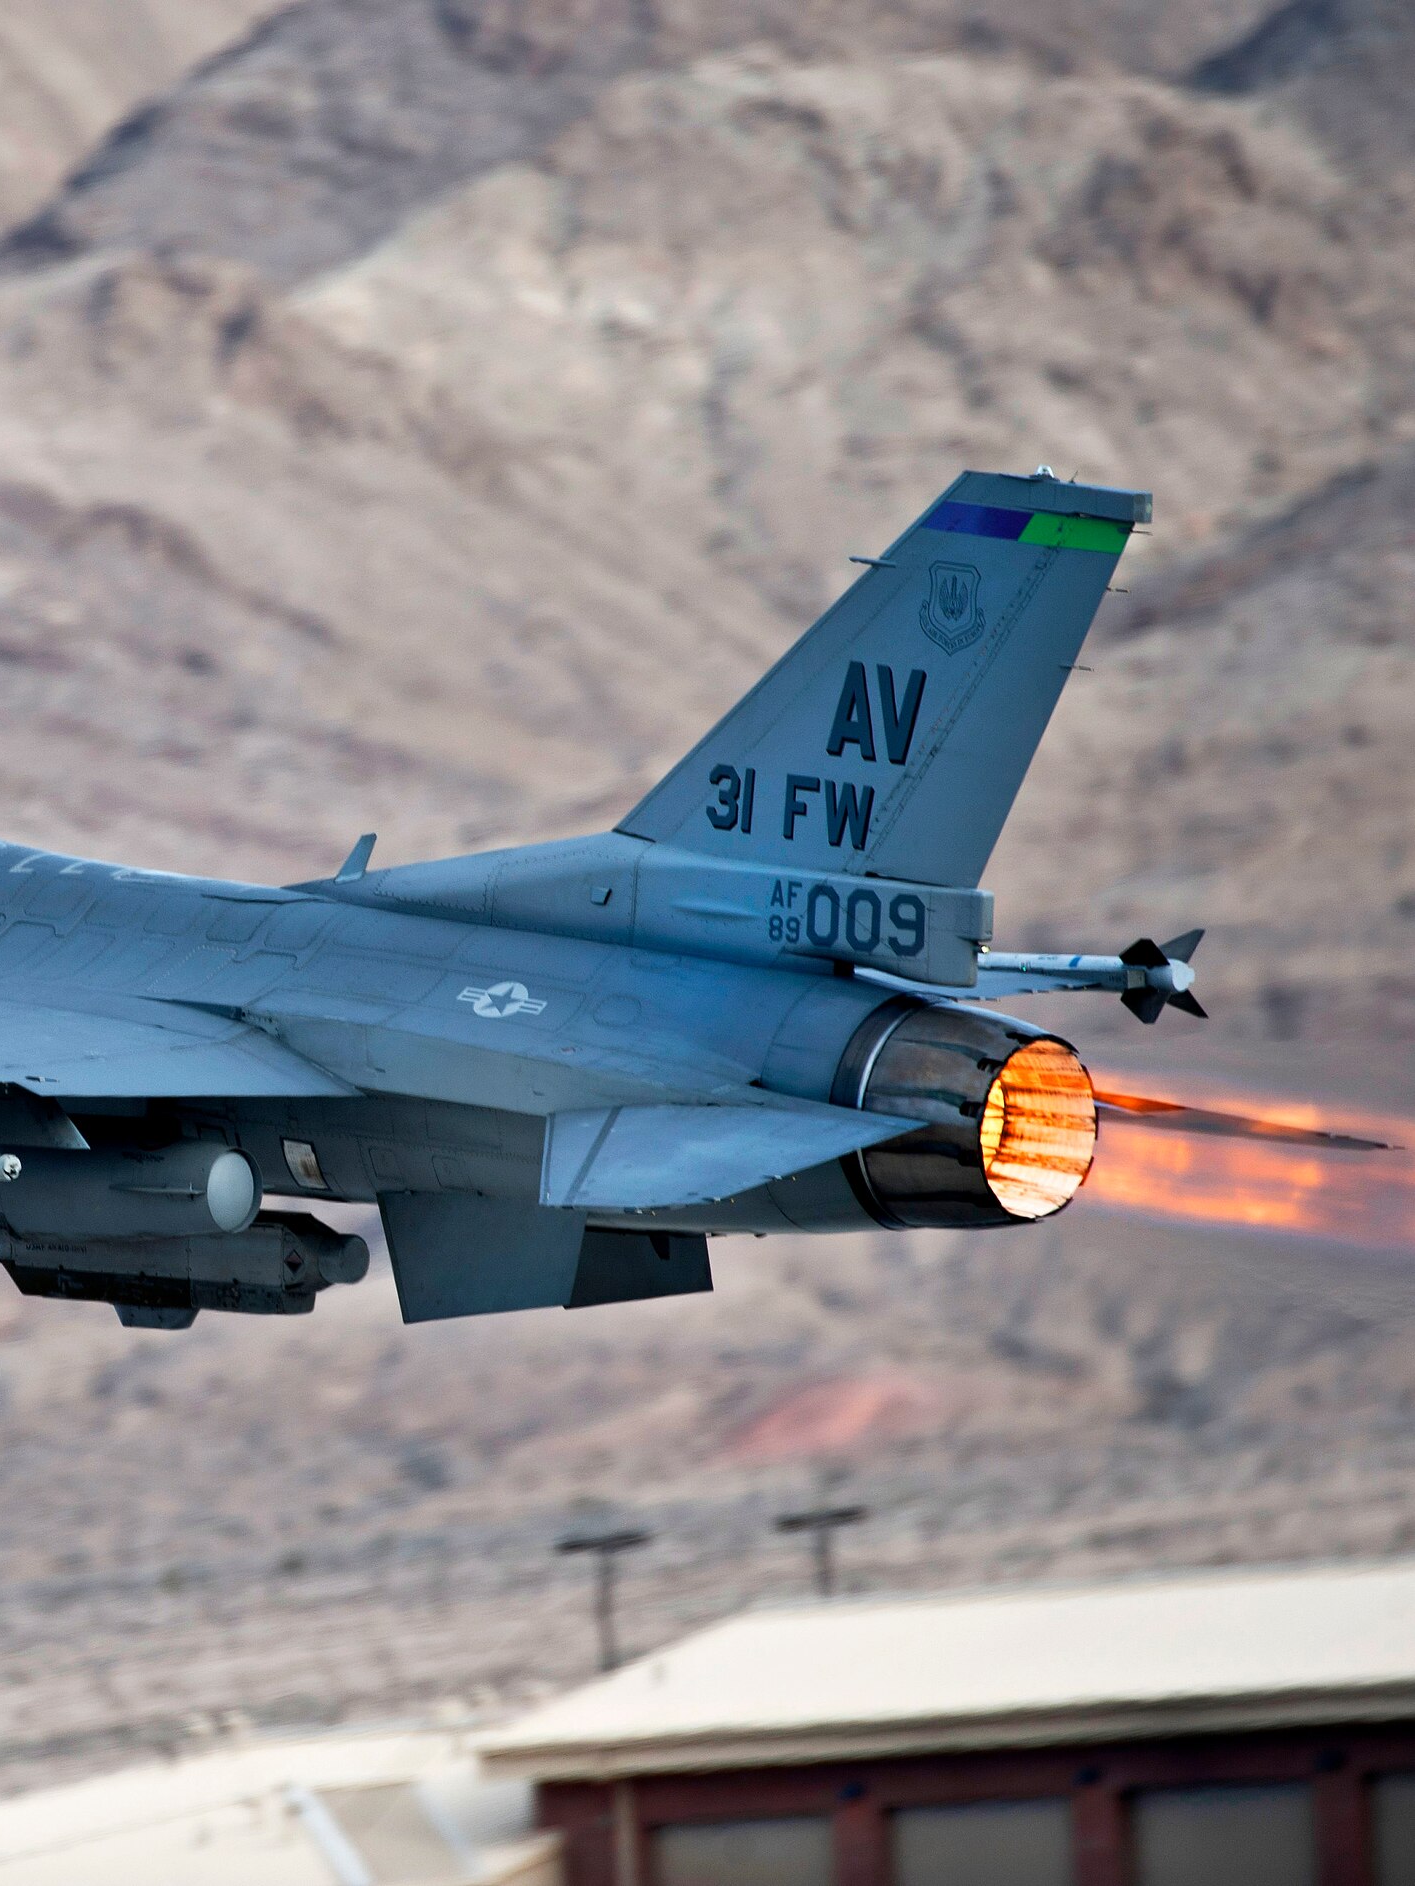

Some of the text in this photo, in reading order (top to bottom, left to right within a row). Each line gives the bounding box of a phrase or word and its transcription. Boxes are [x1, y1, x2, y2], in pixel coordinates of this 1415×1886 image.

[826, 660, 927, 766] AV
[706, 763, 875, 851] 31 FW
[768, 914, 800, 944] 89
[770, 879, 803, 909] AF
[806, 884, 926, 957] 009
